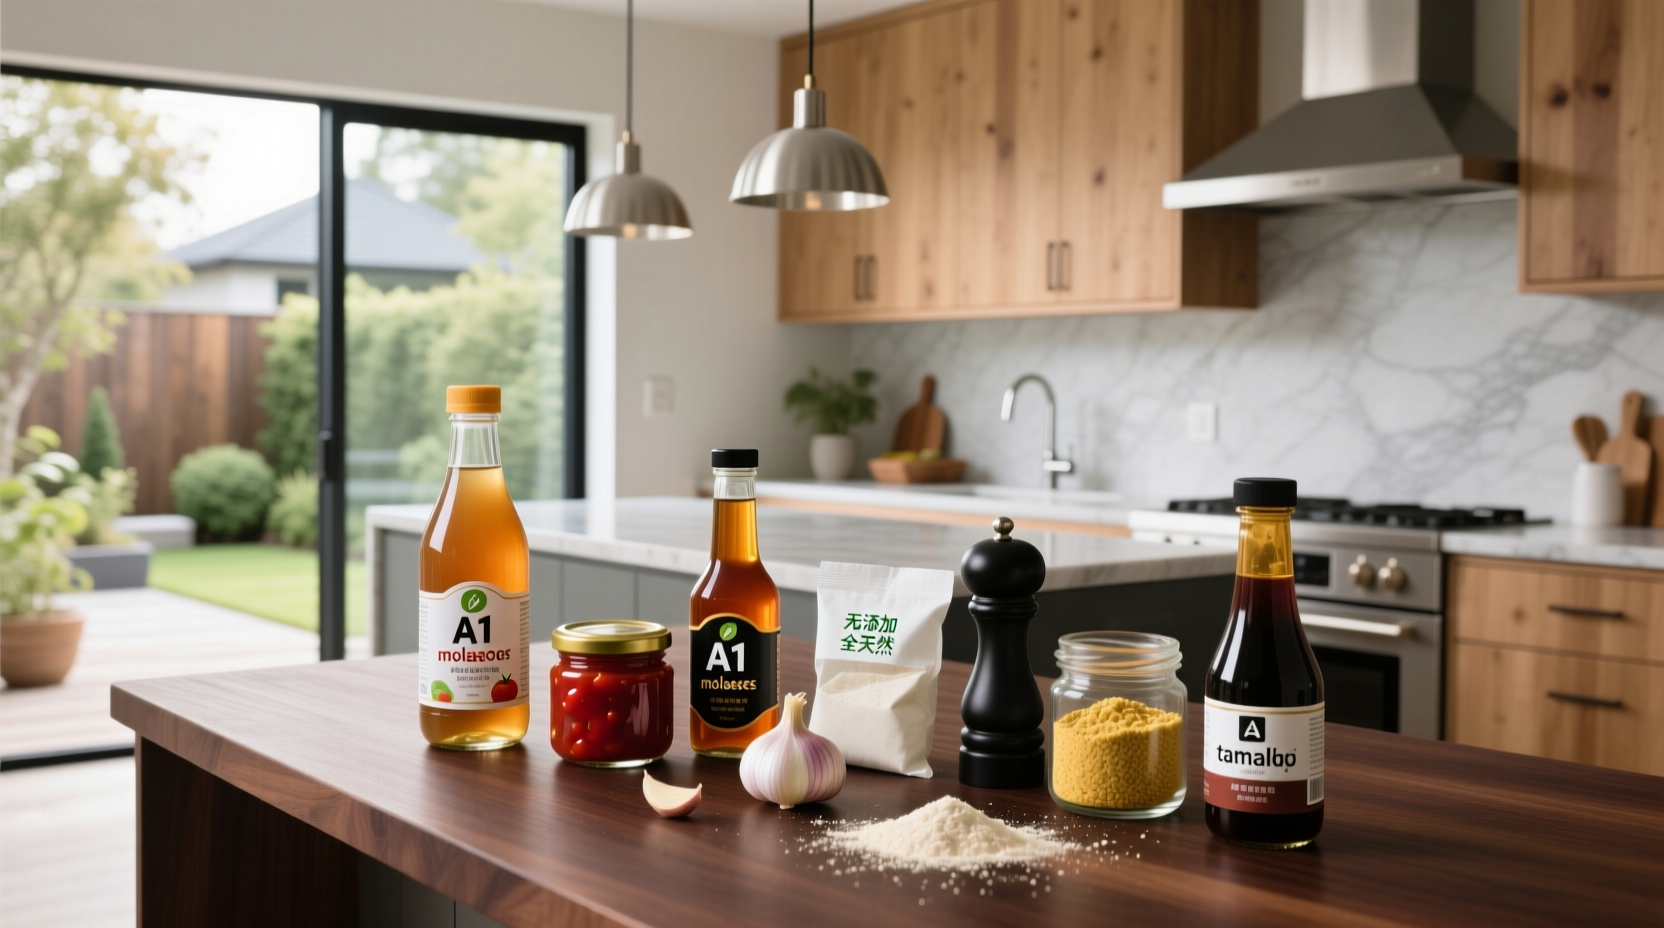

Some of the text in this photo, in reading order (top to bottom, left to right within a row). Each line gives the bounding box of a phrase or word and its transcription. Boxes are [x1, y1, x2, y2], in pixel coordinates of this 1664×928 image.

[452, 615, 491, 644] A1
[843, 612, 898, 634] 无添加
[840, 633, 895, 656] 全天然
[705, 641, 745, 672] A1
[1243, 719, 1261, 739] A
